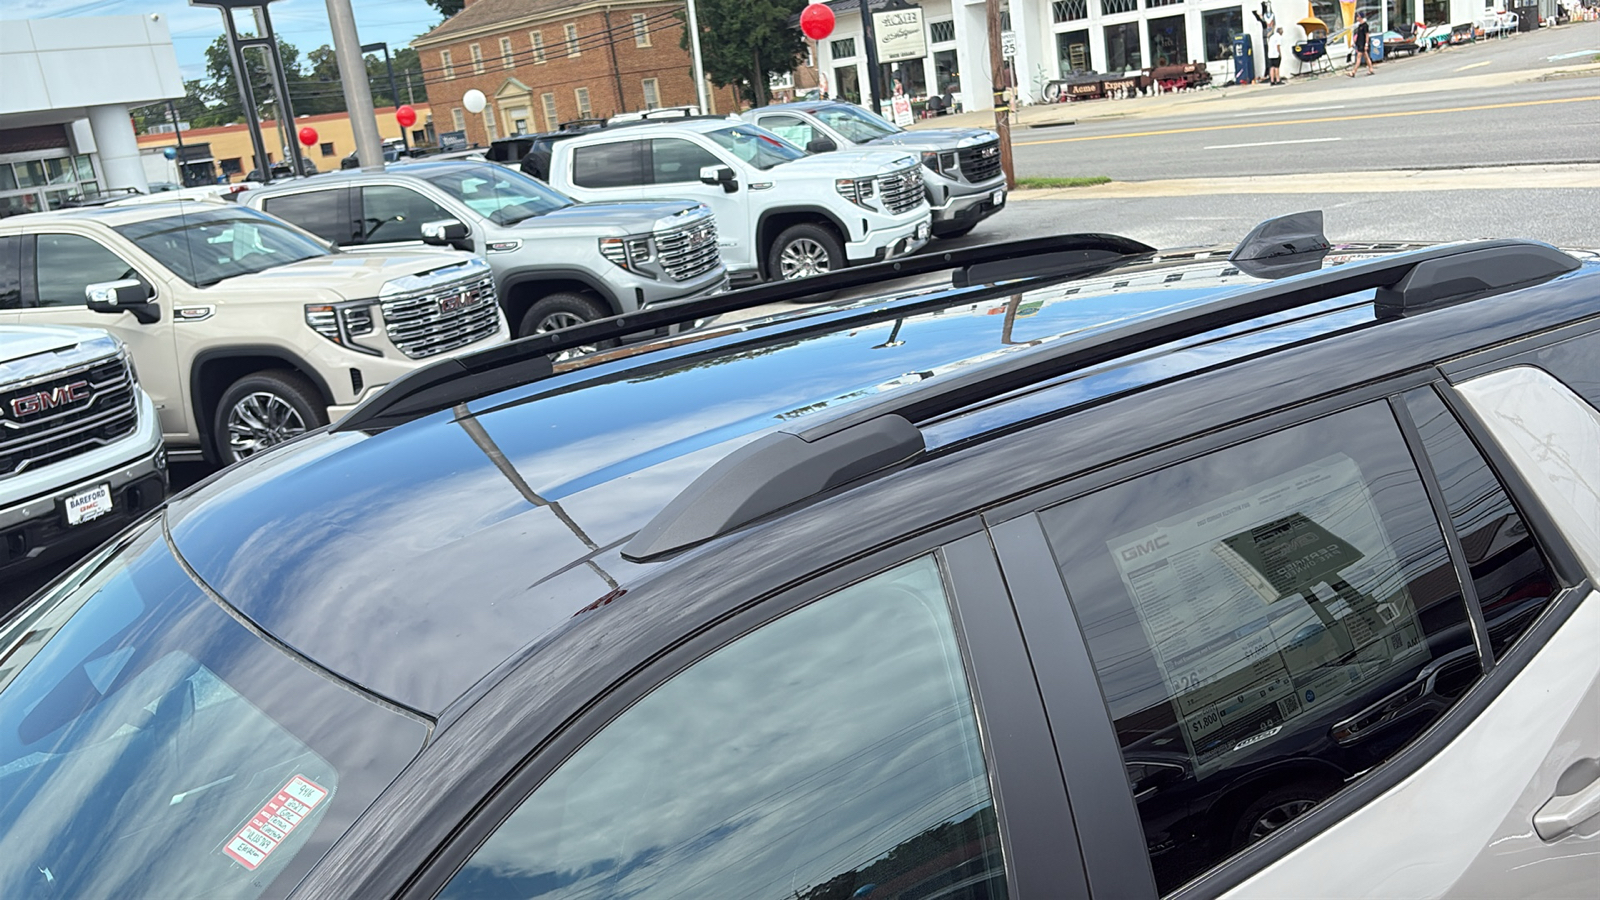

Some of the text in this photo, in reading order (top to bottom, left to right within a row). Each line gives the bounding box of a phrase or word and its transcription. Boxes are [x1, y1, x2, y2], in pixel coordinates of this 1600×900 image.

[1003, 44, 1016, 54] 25
[1072, 79, 1134, 94] Acme Express
[440, 290, 481, 312] GMC
[10, 380, 90, 418] GMC
[70, 489, 106, 509] BAREFORD
[80, 501, 99, 512] GMC
[1121, 534, 1170, 562] GMC
[1180, 672, 1200, 691] 26
[1192, 712, 1218, 733] $1,800
